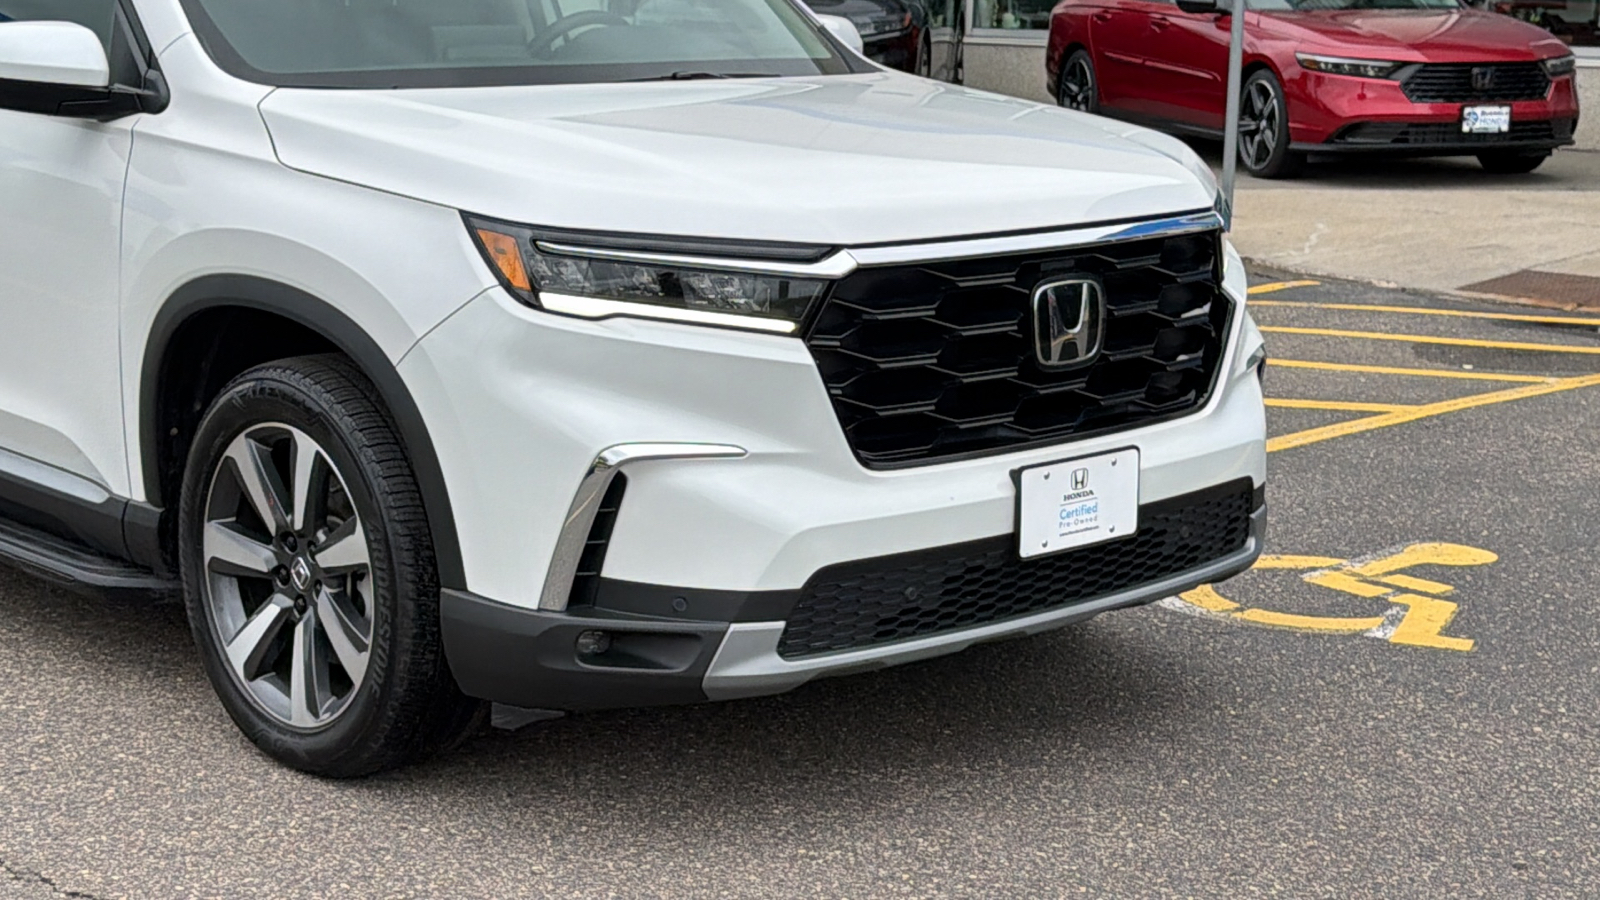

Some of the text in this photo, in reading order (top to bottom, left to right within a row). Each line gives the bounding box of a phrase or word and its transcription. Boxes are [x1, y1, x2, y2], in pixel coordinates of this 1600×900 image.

[1063, 490, 1094, 501] HONDA
[1060, 502, 1098, 520] Certified
[1059, 515, 1098, 528] Pre-Owned
